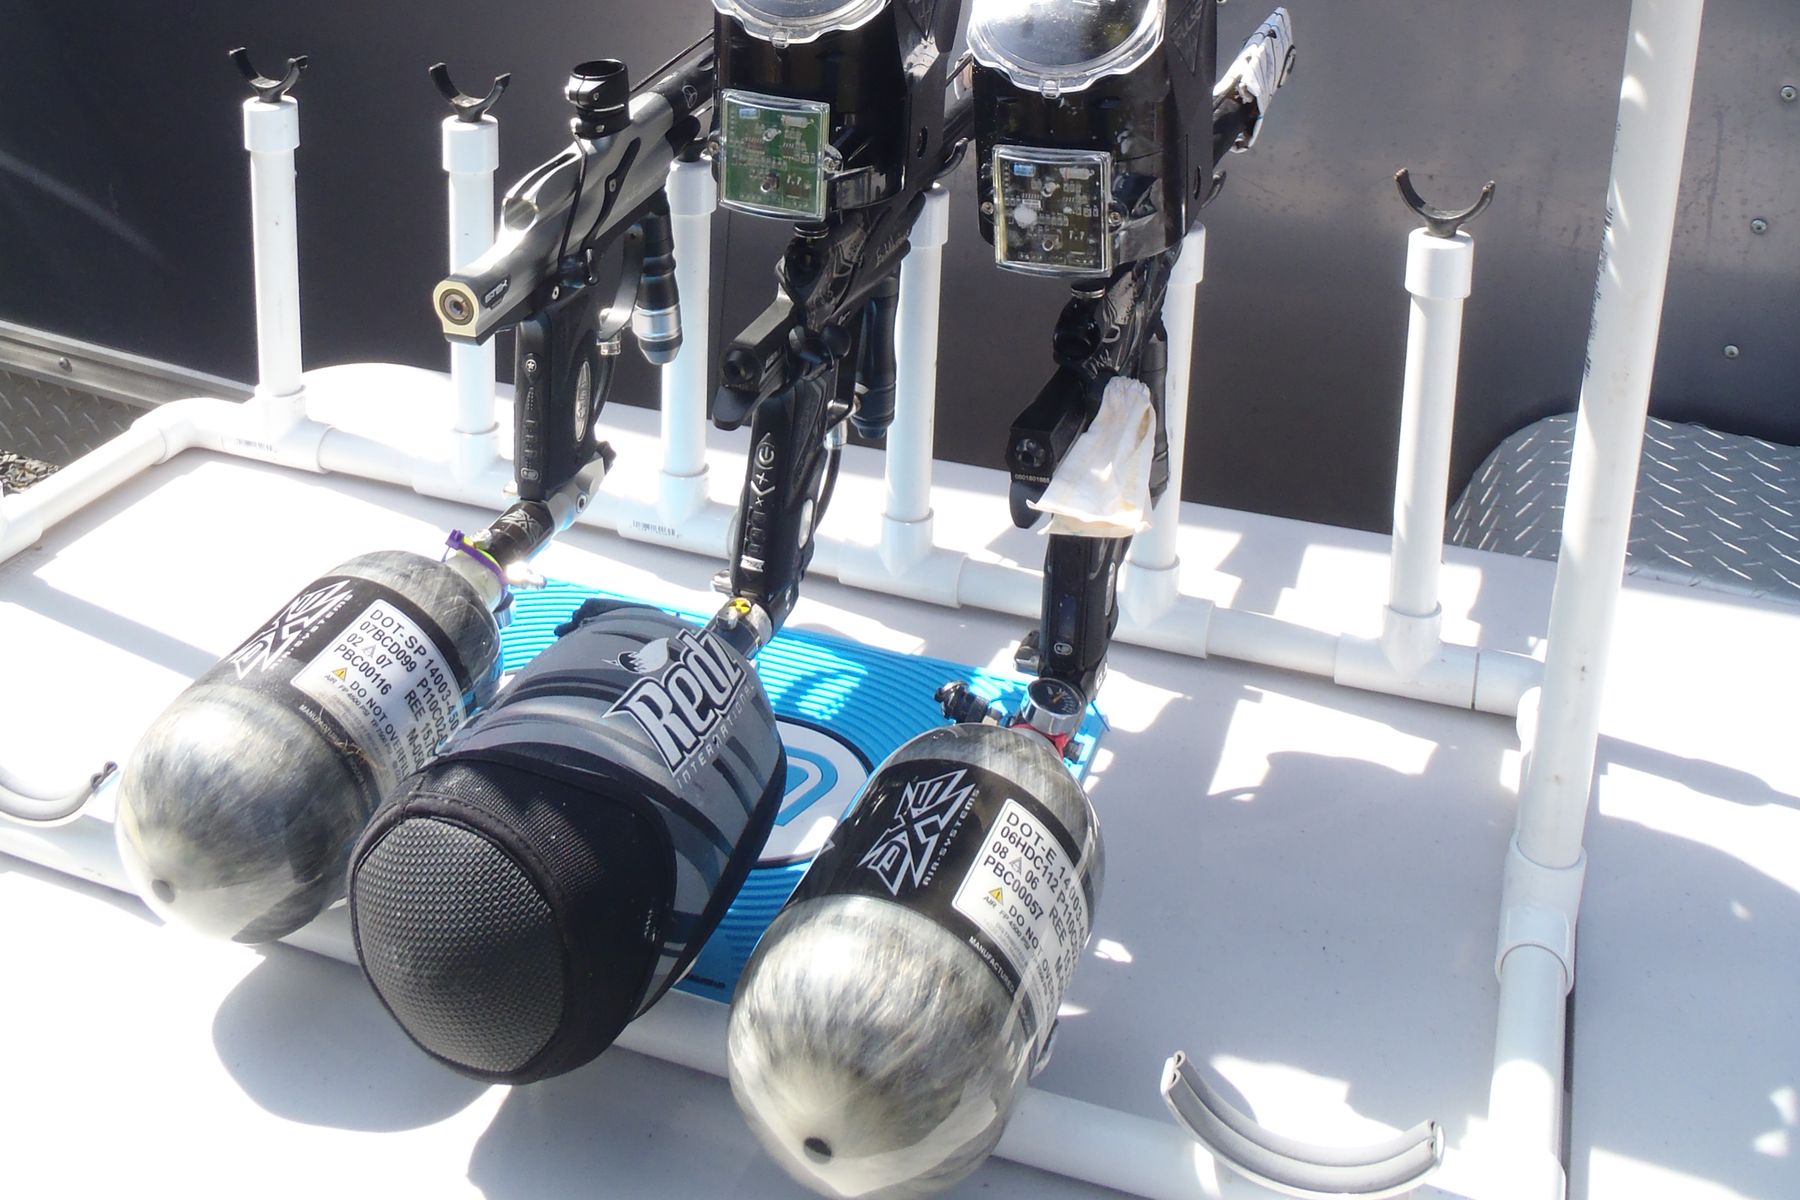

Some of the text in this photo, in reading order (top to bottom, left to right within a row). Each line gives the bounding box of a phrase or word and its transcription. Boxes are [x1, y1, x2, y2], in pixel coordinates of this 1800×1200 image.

[359, 620, 417, 673] 07BCD099
[370, 609, 427, 657] DOT-SP
[334, 643, 393, 696] PBC00116
[346, 633, 364, 648] 02
[375, 654, 393, 670] 07
[404, 689, 425, 722] REE
[350, 680, 367, 698] DO
[366, 698, 388, 724] NOT
[1000, 825, 1059, 894] 06HDC112
[1006, 811, 1057, 866] DOT-E
[983, 856, 1044, 921] PBC00057
[992, 841, 1009, 860] 08
[1025, 870, 1040, 890] 06
[1048, 906, 1067, 947] REE
[1008, 905, 1025, 927] DO
[1025, 927, 1043, 955] NOT
[968, 935, 1015, 993] MANUFACTURED
